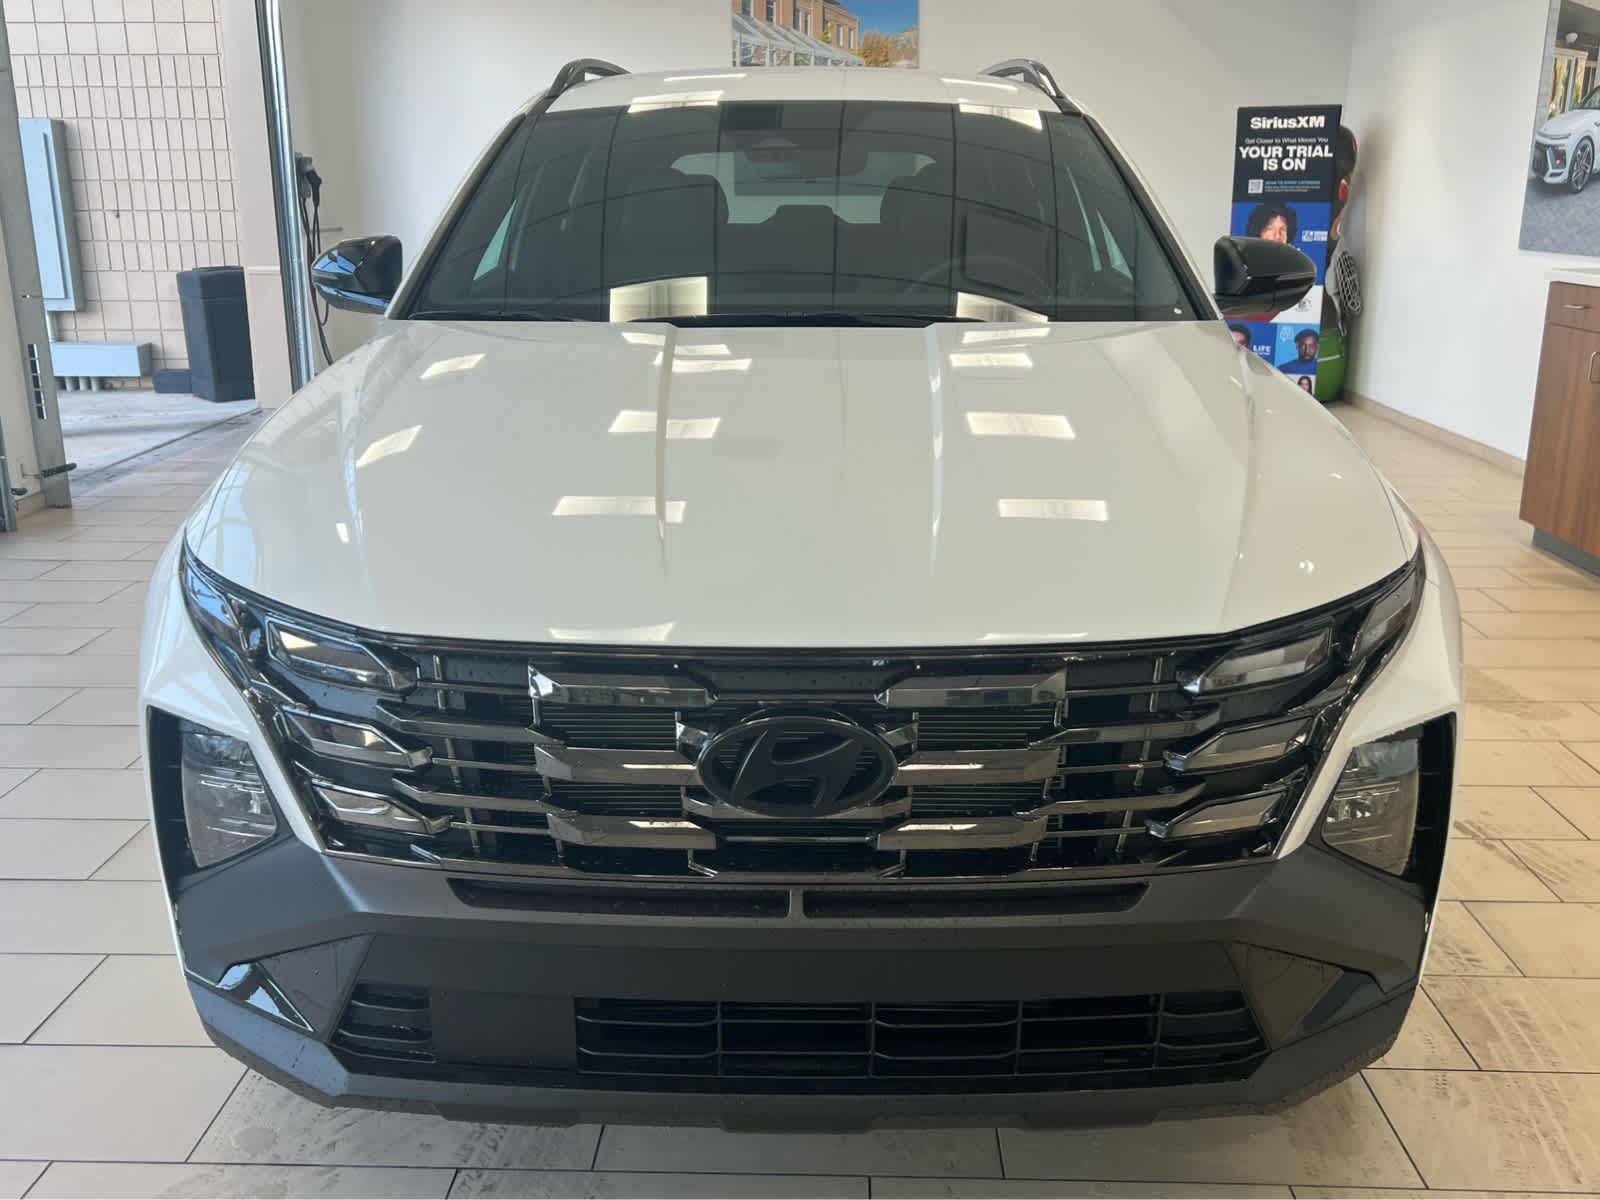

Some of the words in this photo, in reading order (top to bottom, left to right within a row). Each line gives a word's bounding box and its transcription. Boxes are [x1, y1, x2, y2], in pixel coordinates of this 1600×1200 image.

[1250, 115, 1325, 129] SiriusXM
[1239, 145, 1283, 158] YOUR
[1286, 145, 1333, 158] TRIAL
[1263, 158, 1278, 171] IS
[1282, 157, 1306, 171] ON
